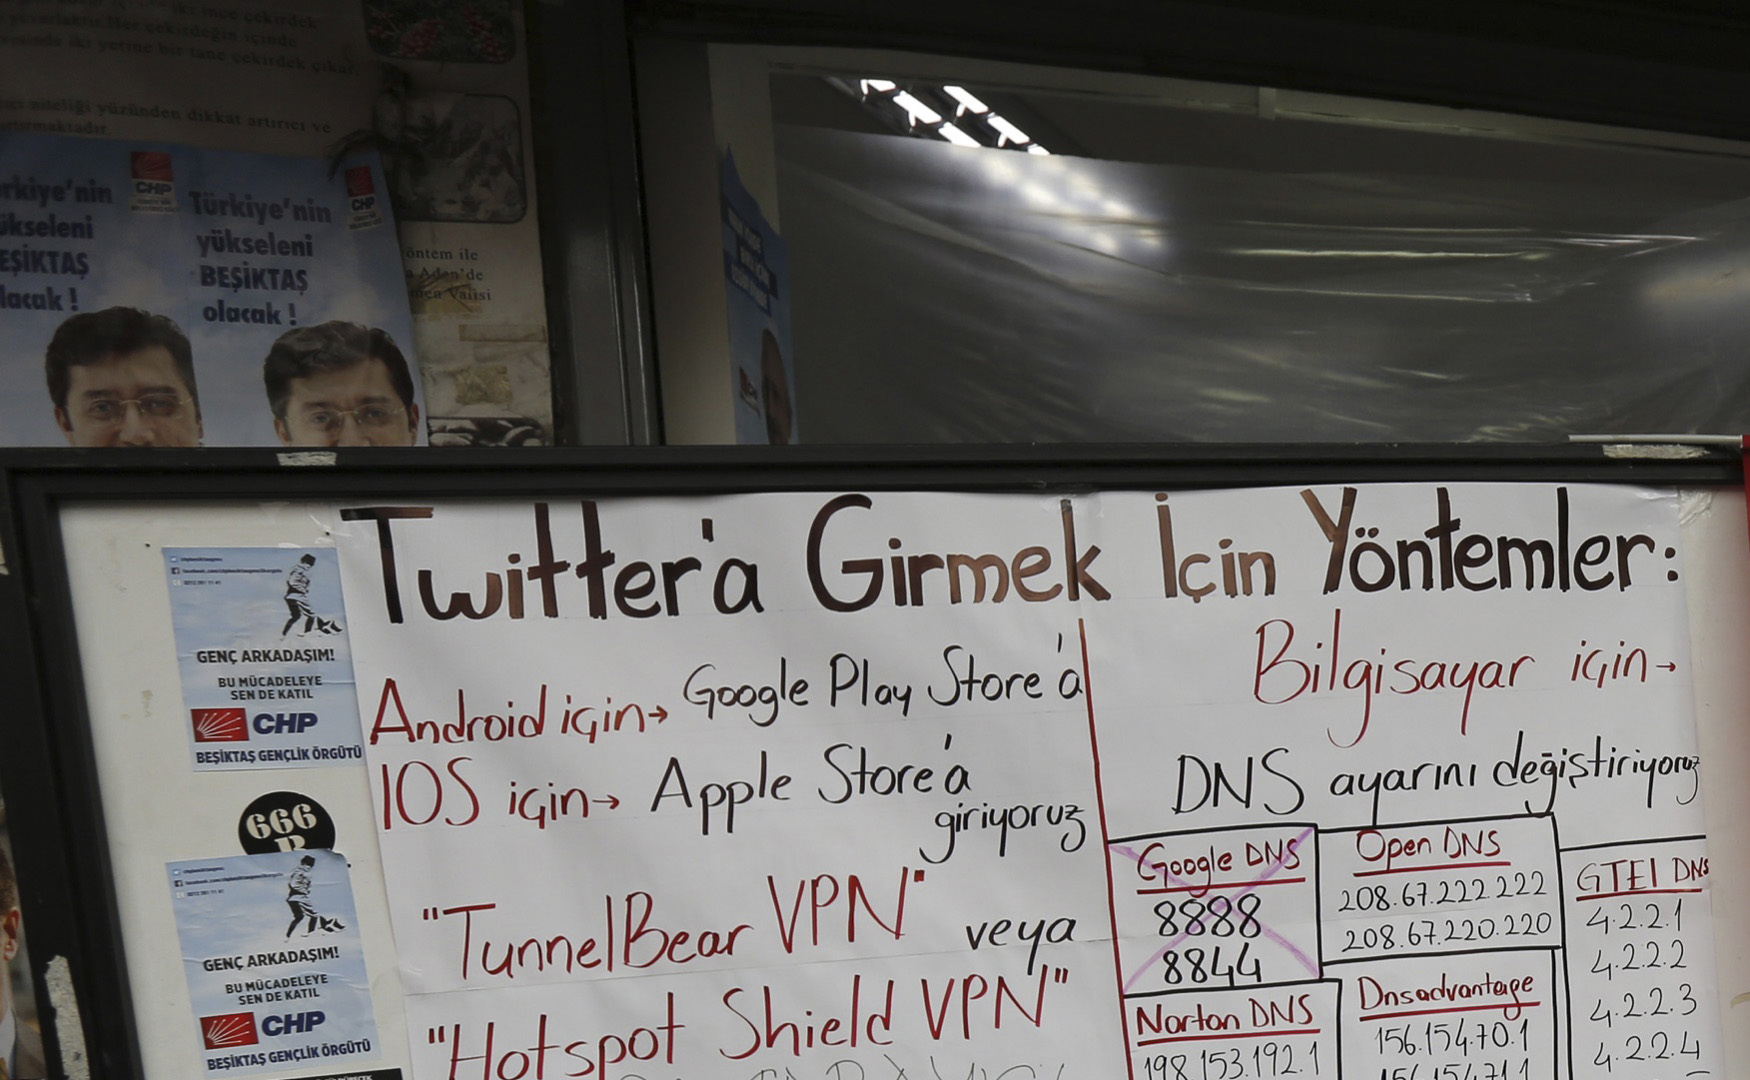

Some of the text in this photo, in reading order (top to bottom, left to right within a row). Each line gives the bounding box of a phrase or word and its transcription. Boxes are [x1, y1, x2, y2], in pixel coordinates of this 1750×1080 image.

[190, 190, 332, 226] Türkiye'nin
[352, 197, 375, 212] CHP
[197, 230, 315, 259] yükseleni
[200, 261, 308, 296] BEŞİKTAŞ
[203, 300, 282, 327] olacak
[341, 486, 1680, 624] Twitter'a Girmek İçin Yöntemler:
[197, 649, 335, 664] GENÇ ARKADAŞIM!
[218, 676, 322, 687] BU MÜCADELEYE
[231, 689, 313, 700] SEN DE KATIL
[369, 633, 1084, 746] Android için Google Play Store'a
[1252, 608, 1650, 749] Bilgisayar için
[253, 712, 318, 734] CHP
[196, 744, 362, 765] BEŞİKTAŞ GENÇLİK ÖRGÜTÜ
[380, 734, 972, 836] IOS için Apple Store'a
[1172, 730, 1702, 828] DNS ayarını değiştiriyoruz
[246, 803, 317, 839] 666
[919, 799, 1087, 865] giriyoruz
[1356, 826, 1501, 872] Open DNS
[1137, 837, 1301, 898] Google DNS
[1674, 857, 1709, 880] DNS
[1339, 871, 1548, 912] 208.67.222.222
[422, 866, 1078, 981] "TunnelBear VPN" veya
[1343, 912, 1551, 953] 208.67.220.220
[1586, 899, 1683, 934] 4.2.2.1
[203, 946, 339, 971] GENÇ ARKADAŞIM!
[1592, 940, 1688, 980] 4.2.2.2
[225, 974, 328, 993] BU MÜCADELEYE
[239, 988, 319, 1005] SEN DE KATIL
[1359, 973, 1534, 1021] Dnsadvantage
[719, 974, 896, 1061] Shield
[920, 964, 1070, 1040] VPN"
[1137, 994, 1315, 1036] Norton DNS
[1590, 983, 1697, 1027] 4.2.2.3
[262, 1011, 325, 1036] CHP
[207, 1039, 371, 1071] BEŞİKTAŞ GENÇLİK ÖRGÜTÜ
[1593, 1030, 1701, 1073] 4.2.2.4
